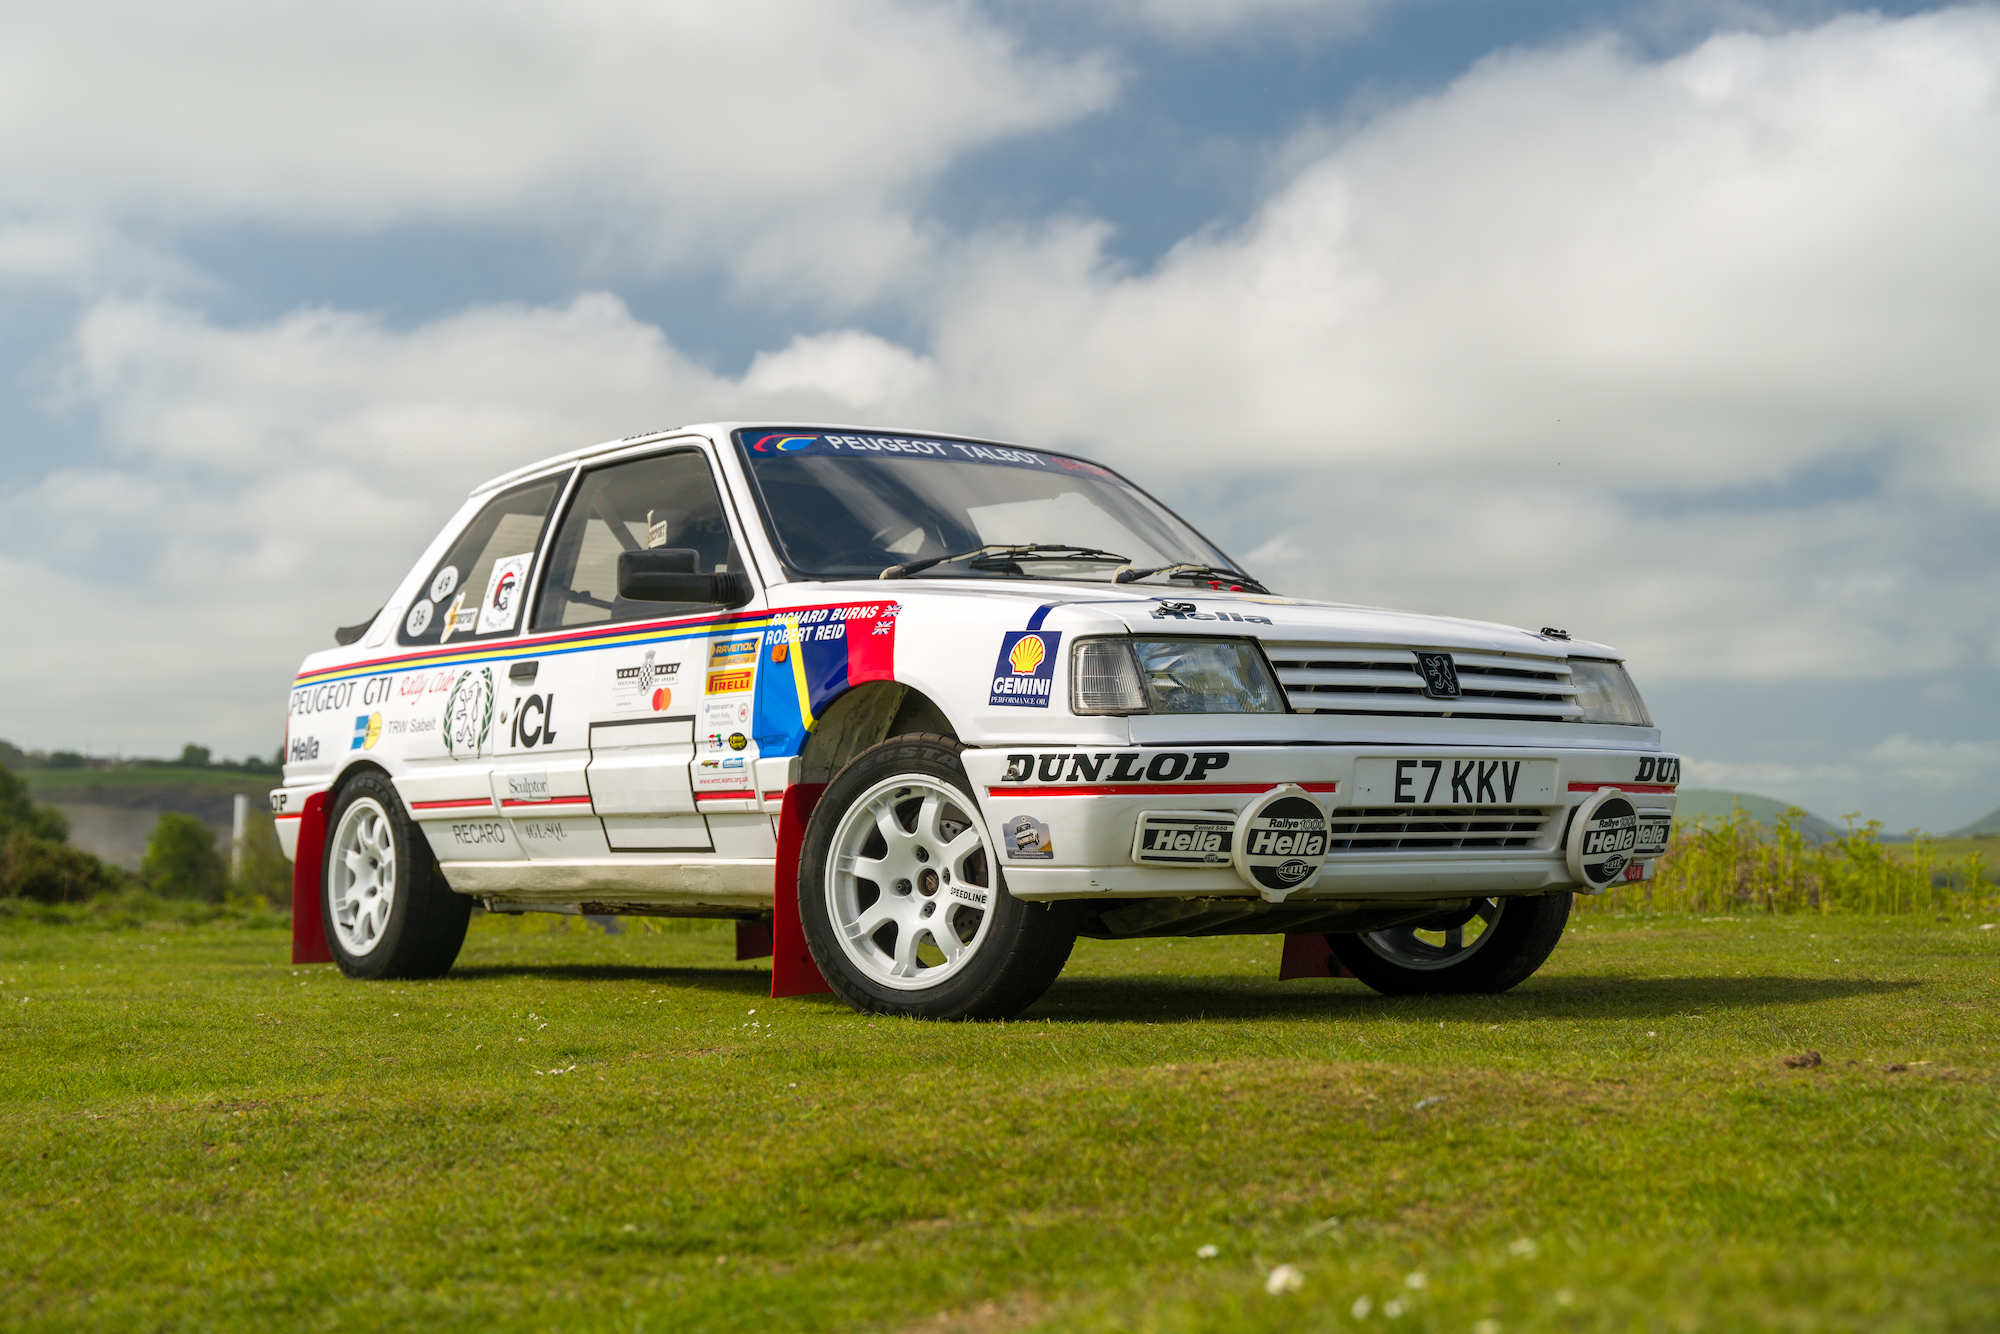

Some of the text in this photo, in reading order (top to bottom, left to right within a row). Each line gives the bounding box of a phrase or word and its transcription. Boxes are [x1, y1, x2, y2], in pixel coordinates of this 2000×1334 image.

[824, 435, 947, 456] PEUGEOT
[952, 444, 1046, 466] TALBOT
[438, 576, 451, 593] 49
[412, 609, 426, 628] 36
[771, 605, 880, 627] RICHARD BURNS
[765, 623, 846, 646] ROBERT REID
[715, 642, 754, 655] RAVENOL
[289, 668, 456, 716] PEUGEOT GTI Rally Club
[708, 671, 751, 692] PIRELLI
[992, 677, 1051, 696] GEMINI
[991, 696, 1048, 706] PERFORMANCE OIL
[388, 720, 408, 735] TRW
[410, 718, 437, 733] Sabelt
[290, 736, 320, 762] Hella
[1001, 752, 1230, 782] DUNLOP
[509, 777, 547, 798] Sculptor
[1394, 760, 1521, 803] E7 KKV
[452, 823, 505, 844] RECARO
[1269, 818, 1326, 831] Rallye 1000
[1599, 819, 1620, 829] Rallye
[1153, 830, 1222, 852] Hella
[1252, 831, 1323, 856] Hella
[1586, 830, 1635, 854] Hella
[1280, 864, 1309, 876] HELLA
[950, 886, 987, 904] SPEEDLINE
